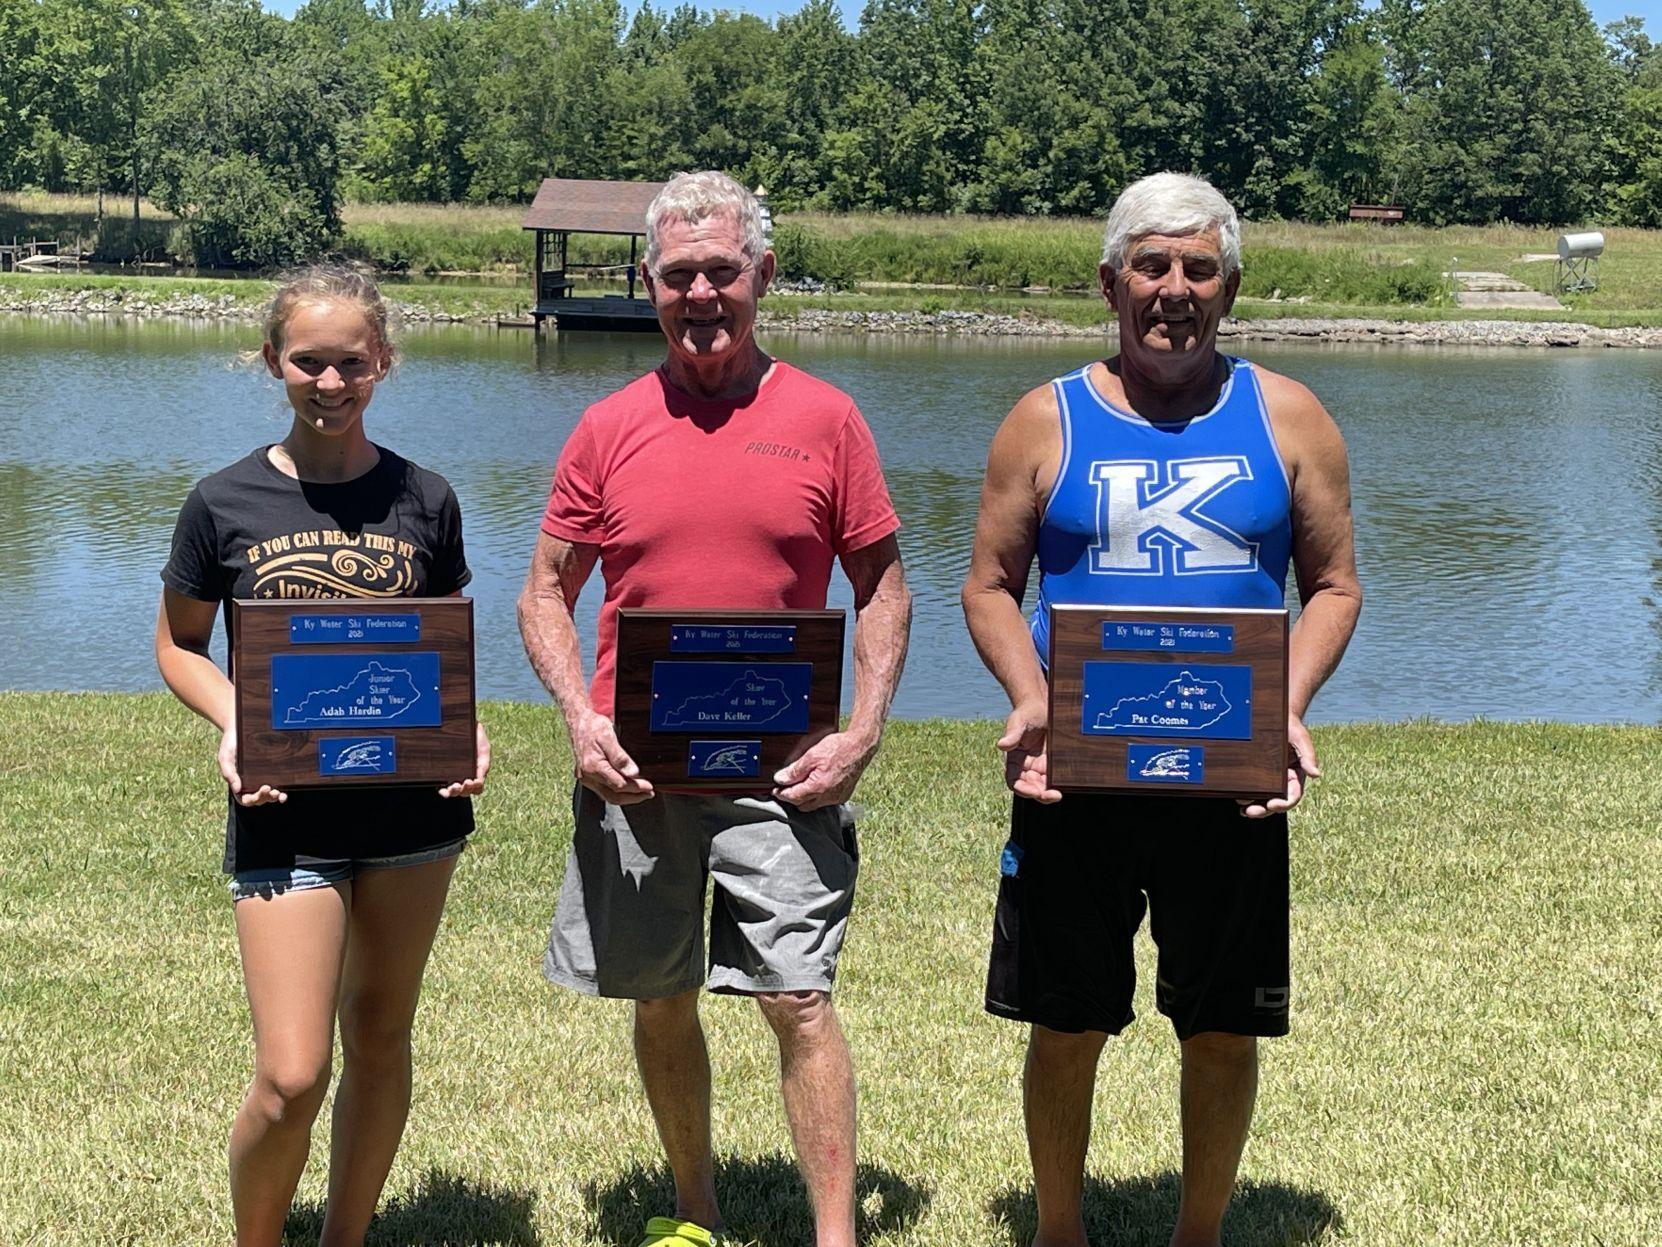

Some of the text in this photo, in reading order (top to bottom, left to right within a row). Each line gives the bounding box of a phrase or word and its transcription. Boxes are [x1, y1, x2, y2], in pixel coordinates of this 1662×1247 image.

[744, 441, 801, 461] PROSTAR
[1087, 455, 1260, 576] K
[246, 530, 418, 564] IF YOU CAN READ THIS MY
[304, 618, 407, 630] Ky Water Ski Federation
[744, 630, 783, 639] Federation
[1116, 625, 1220, 639] Ky Water Ski Federation
[368, 674, 395, 684] Junior
[369, 684, 391, 695] Skier
[356, 695, 406, 705] of the Year
[1180, 699, 1194, 710] the
[1199, 700, 1217, 710] Year
[319, 706, 382, 717] Adah Hardin
[698, 711, 752, 721] Dave Keller
[1131, 714, 1189, 725] Pat Coomes
